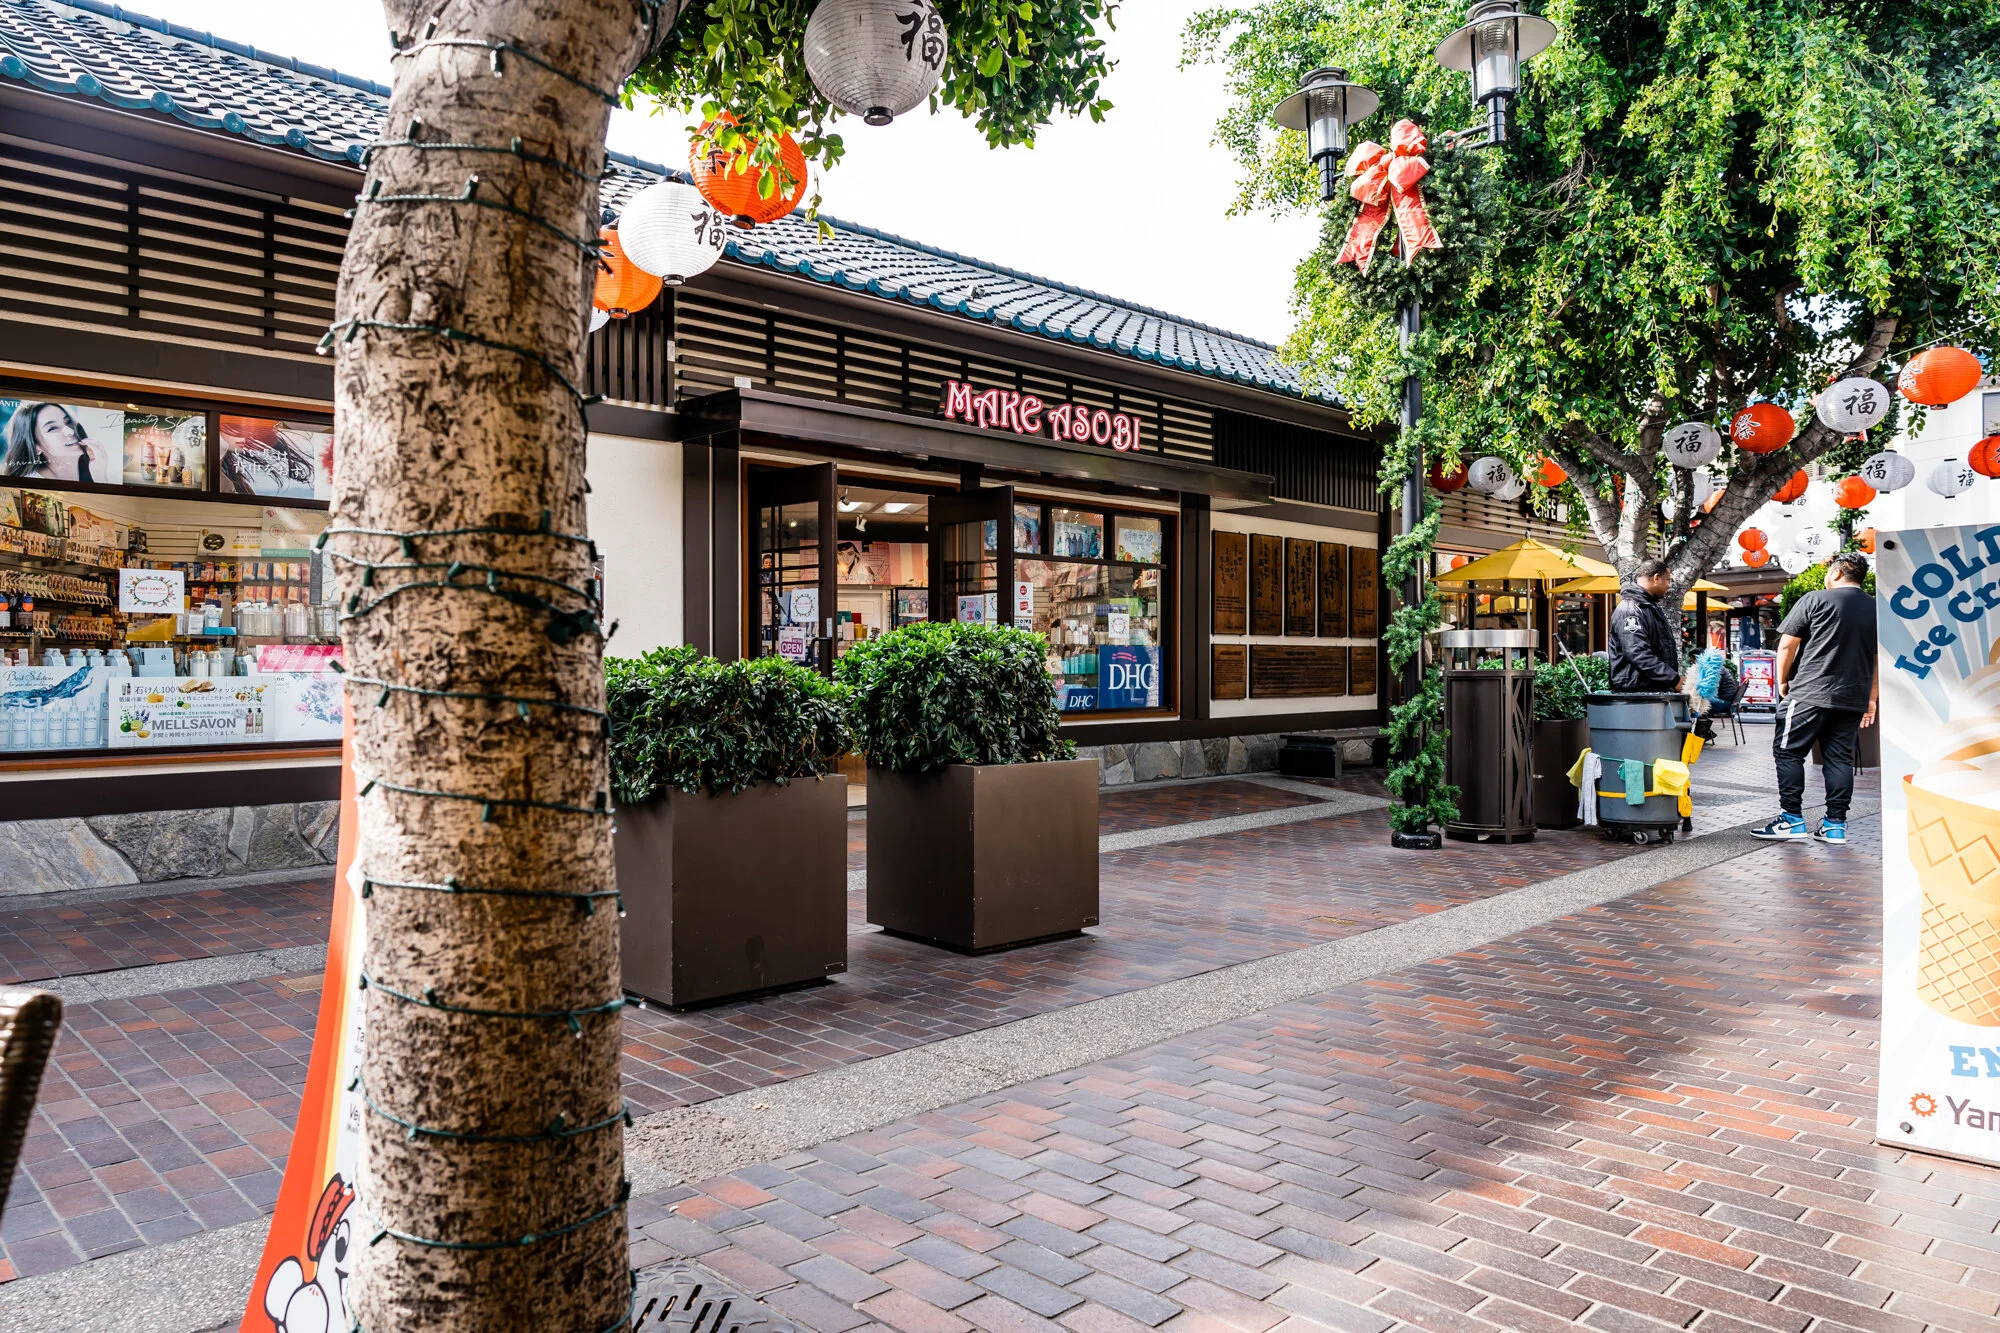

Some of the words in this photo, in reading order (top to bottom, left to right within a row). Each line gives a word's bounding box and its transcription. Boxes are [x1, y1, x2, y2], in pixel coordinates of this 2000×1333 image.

[895, 0, 945, 70] 福
[691, 199, 726, 251] 福
[1842, 387, 1877, 416] 福
[944, 379, 1044, 434] MAKE
[1048, 403, 1141, 452] ASOBI
[1733, 413, 1761, 440] 祭
[1674, 430, 1702, 453] 福
[1486, 463, 1506, 483] 福
[1865, 459, 1886, 480] 福
[1957, 469, 1975, 486] 福
[1890, 525, 2000, 619] COLD
[1894, 624, 1957, 680] Ice
[1948, 578, 2000, 622] Cr
[782, 642, 802, 653] OPEN
[1108, 663, 1156, 690] DHC
[1069, 694, 1094, 708] DHC
[151, 717, 236, 731] MELLSAVON
